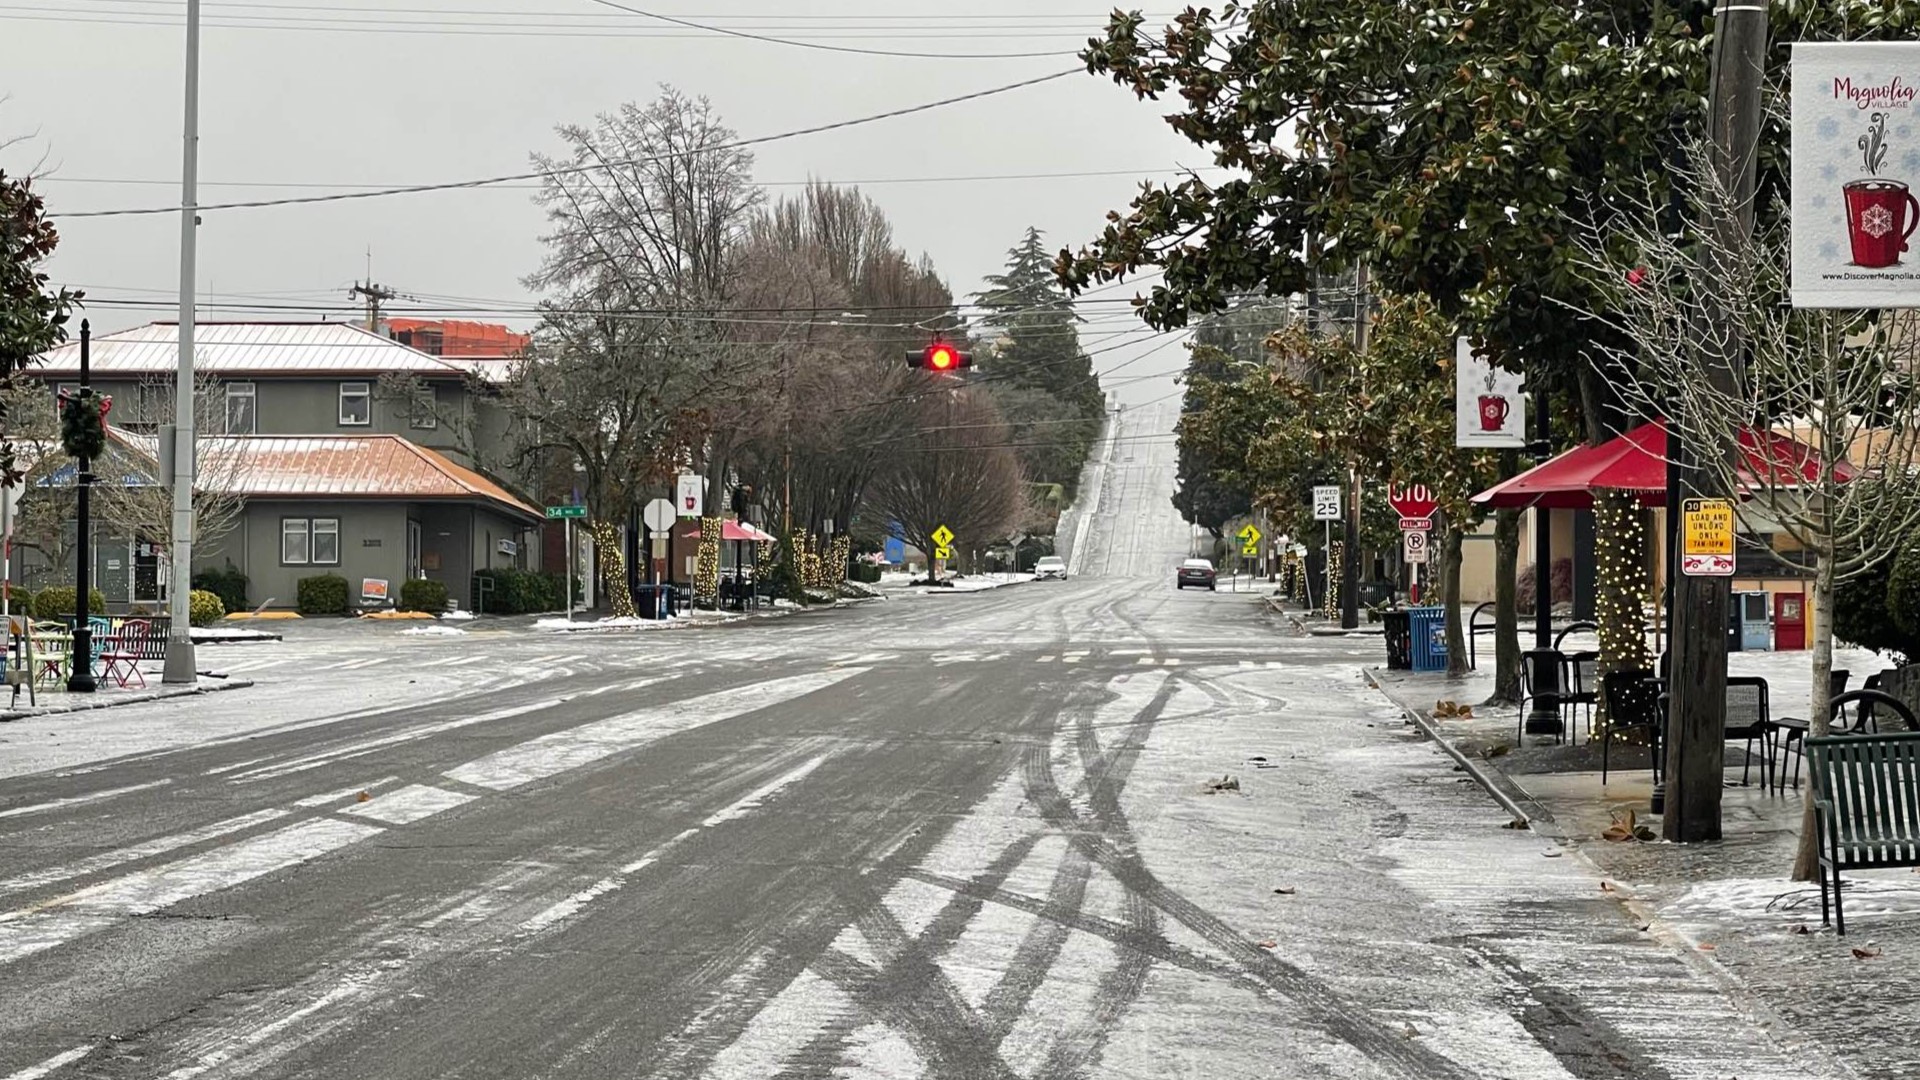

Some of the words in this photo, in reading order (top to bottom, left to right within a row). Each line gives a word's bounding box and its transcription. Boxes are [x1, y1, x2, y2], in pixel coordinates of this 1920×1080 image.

[1834, 76, 1918, 109] Magnolia
[1317, 503, 1338, 515] 25
[1687, 502, 1699, 511] 30
[549, 508, 562, 517] 34
[1691, 513, 1710, 521] LOAD
[1713, 513, 1728, 521] AND
[1693, 522, 1724, 530] UNLOAD
